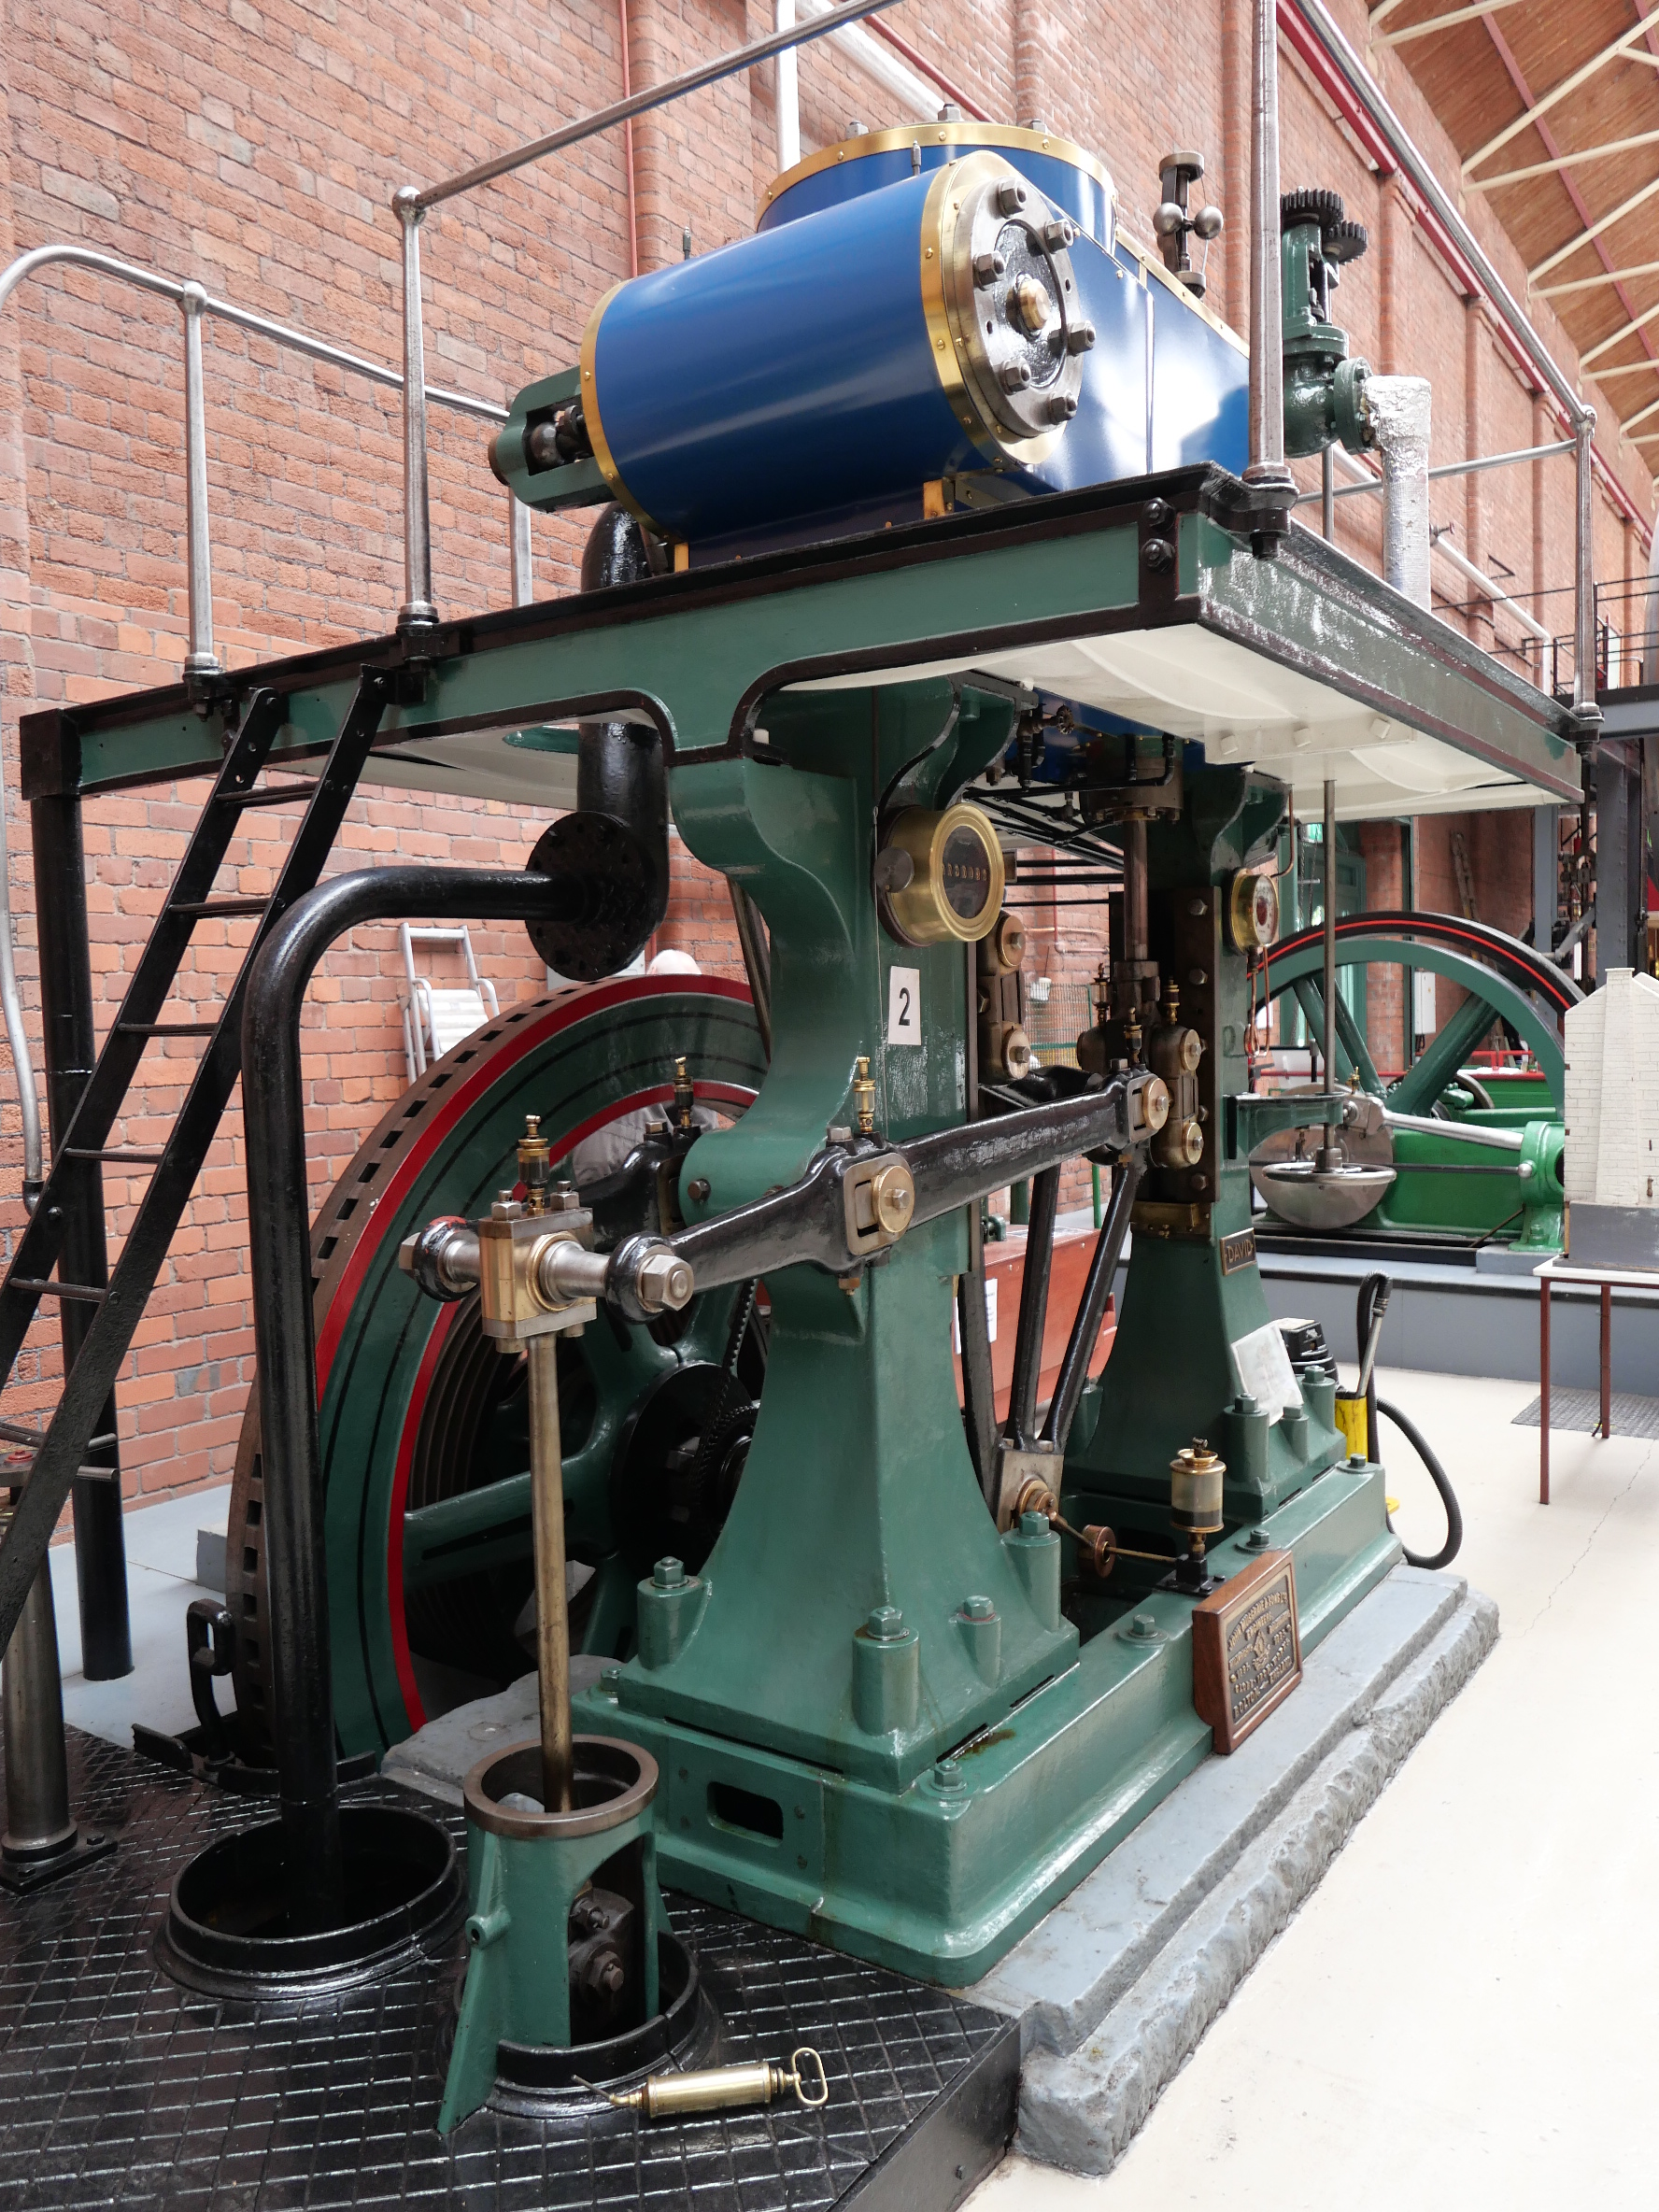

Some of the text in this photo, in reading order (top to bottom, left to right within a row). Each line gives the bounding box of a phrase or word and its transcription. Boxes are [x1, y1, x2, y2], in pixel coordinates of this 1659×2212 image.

[898, 986, 911, 1027] 2
[1227, 1240, 1253, 1263] DAVID
[1228, 1624, 1242, 1652] JOHN
